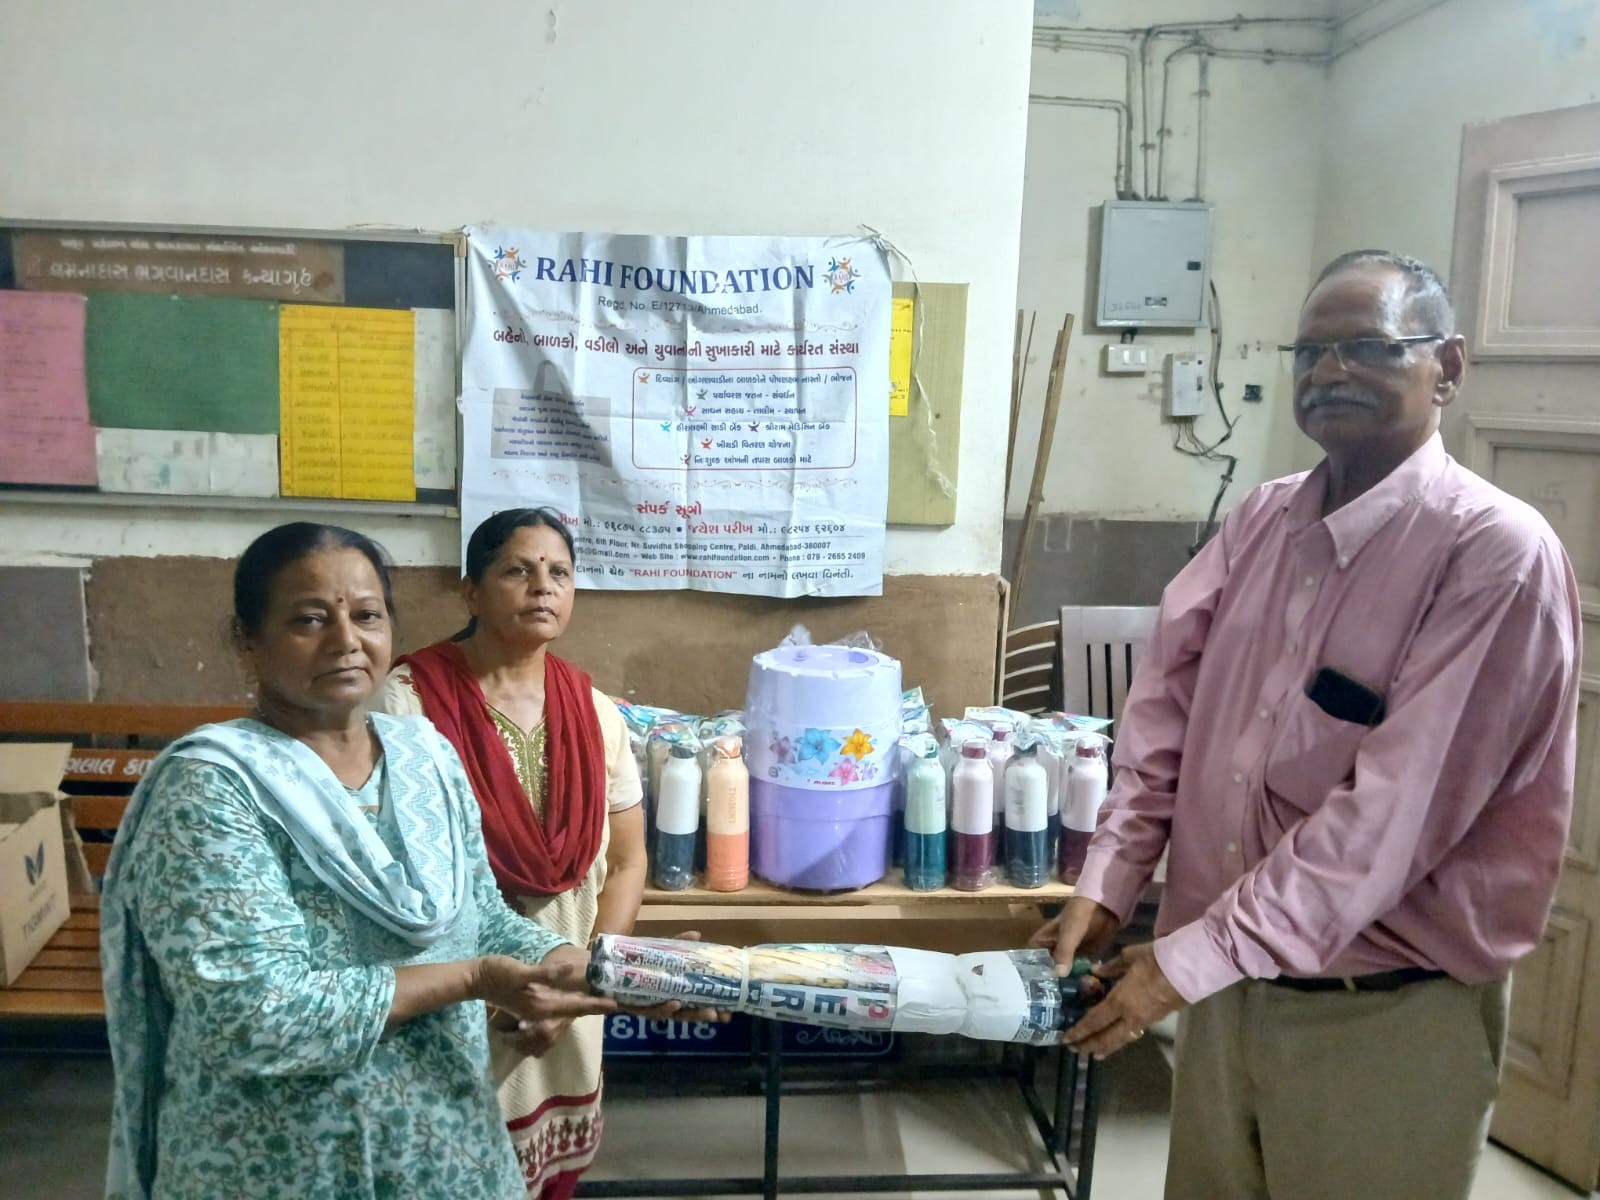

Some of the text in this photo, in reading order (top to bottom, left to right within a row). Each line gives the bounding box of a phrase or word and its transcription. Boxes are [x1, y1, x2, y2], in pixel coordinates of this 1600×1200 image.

[535, 256, 614, 287] RAHI
[619, 264, 815, 295] FOUNDATION
[533, 331, 578, 352] બાળકો,
[584, 336, 619, 354] વડીલો
[624, 338, 648, 356] અને
[705, 339, 755, 362] સુખાકારી
[760, 340, 781, 357] માટે
[786, 338, 824, 356] કાર્યરત
[829, 338, 860, 355] સંસ્થા
[768, 439, 791, 449] યોજના
[636, 500, 671, 515] સંપર્ક
[688, 521, 719, 534] જયેશ
[723, 520, 753, 534] પરીખ
[642, 542, 672, 550] Suvidha
[674, 543, 708, 551] Shopping
[709, 543, 736, 552] Centre,
[806, 553, 820, 561] 079
[742, 571, 754, 580] ના
[791, 571, 818, 580] લખવા
